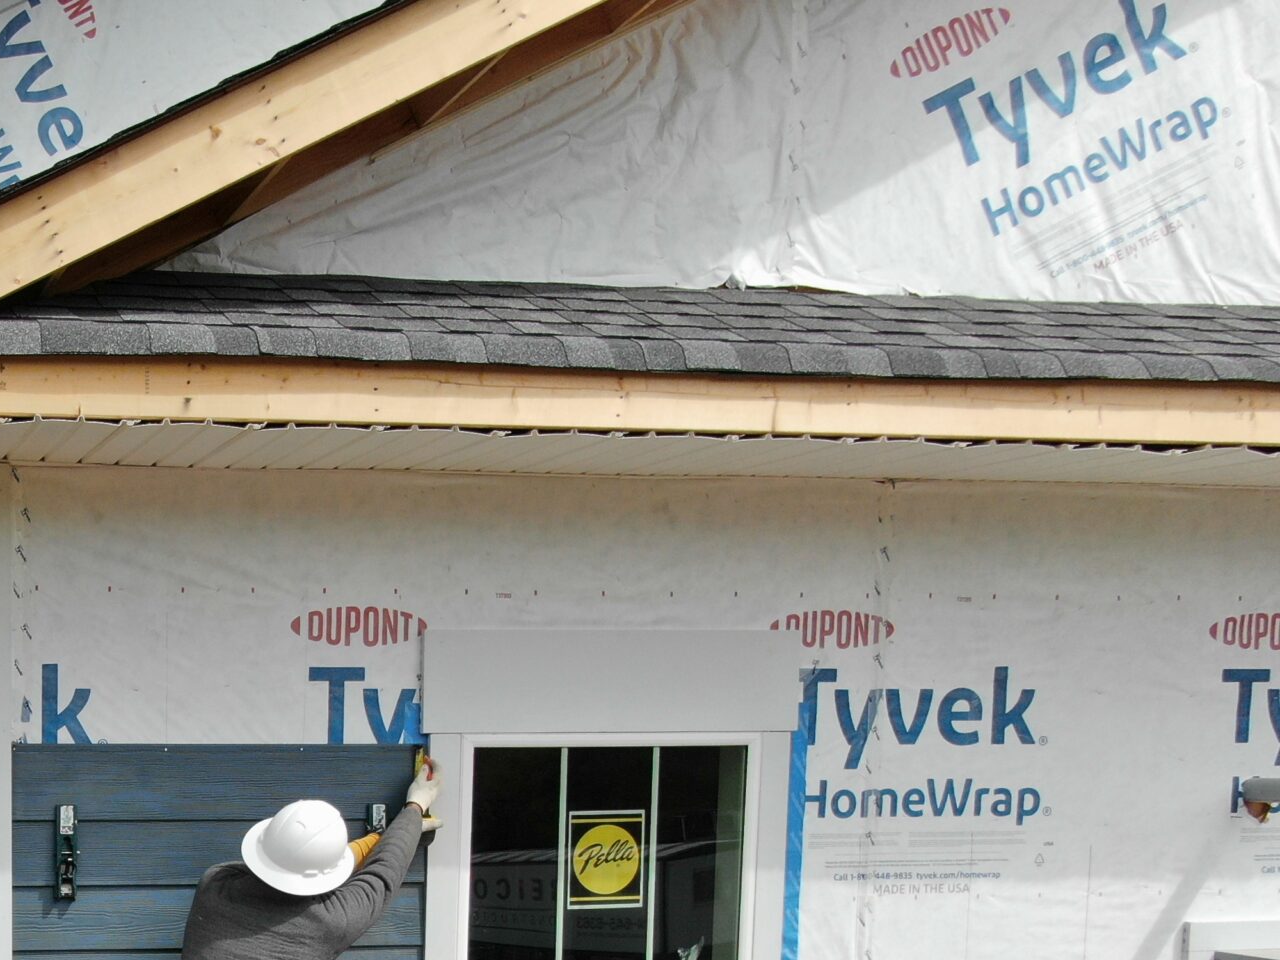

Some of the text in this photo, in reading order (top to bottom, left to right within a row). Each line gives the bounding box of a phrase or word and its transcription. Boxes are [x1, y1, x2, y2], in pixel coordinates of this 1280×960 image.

[900, 7, 1000, 78] DUPONT
[922, 0, 1187, 169] Tyvek
[980, 96, 1219, 238] HomeWrap
[308, 606, 413, 647] DUPONT
[798, 666, 1036, 770] Tyvek
[804, 778, 1041, 826] HomeWrap
[578, 839, 634, 875] Pella
[872, 882, 970, 895] MADE IN THE USA
